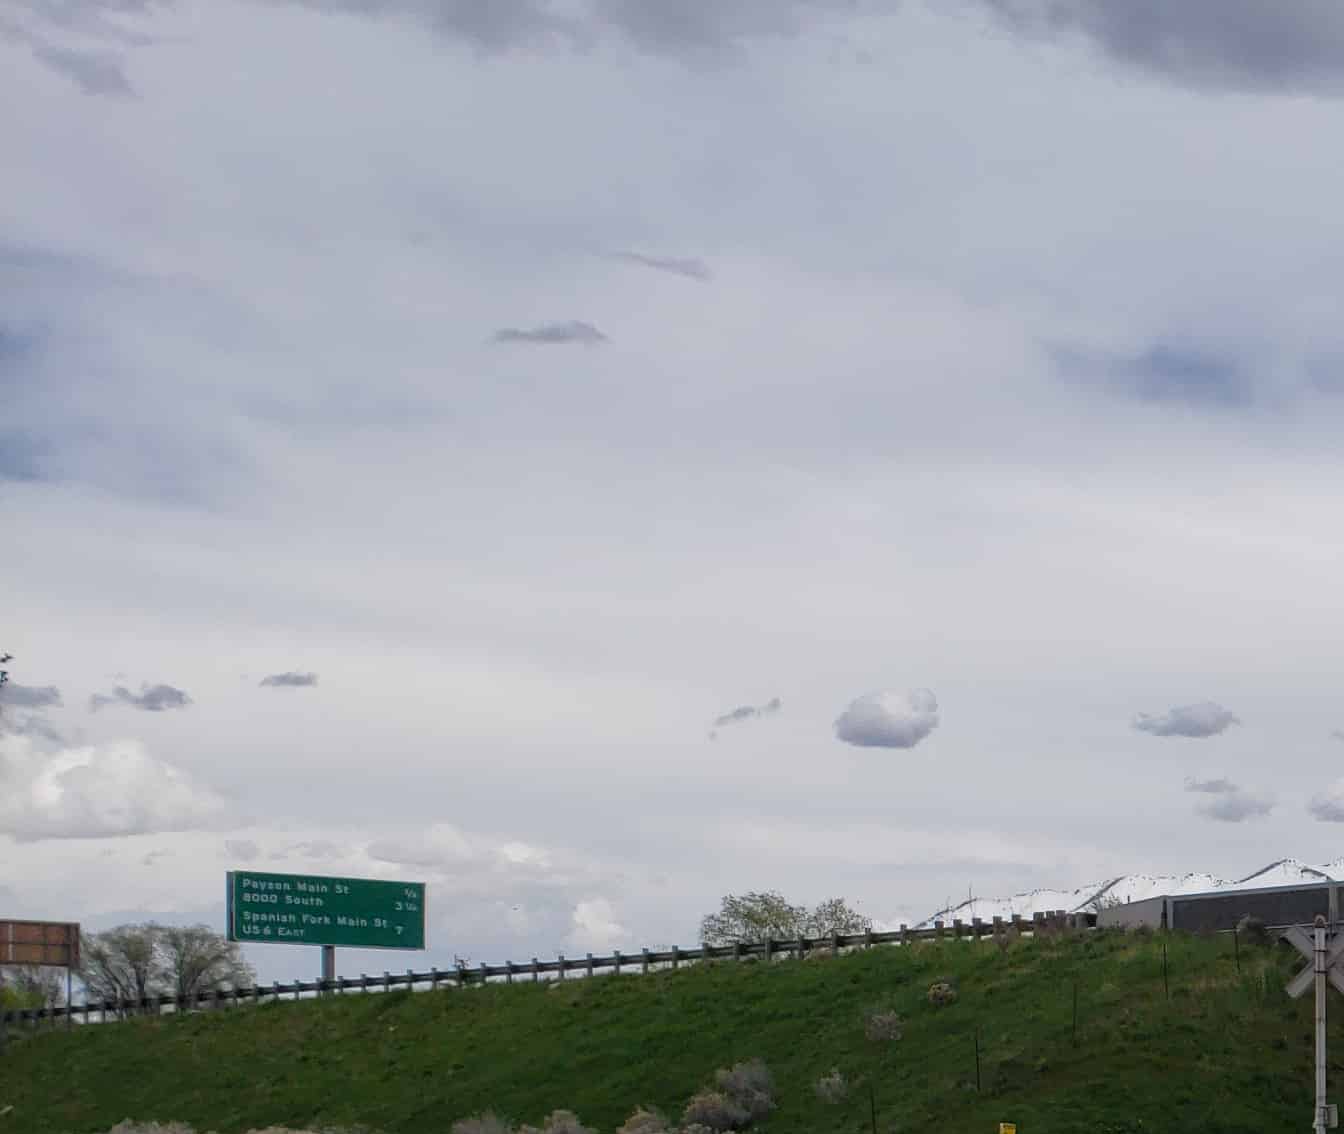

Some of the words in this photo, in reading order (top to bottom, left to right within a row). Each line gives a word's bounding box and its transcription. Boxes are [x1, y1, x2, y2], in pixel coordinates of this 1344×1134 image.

[242, 878, 291, 891] Payson
[297, 881, 328, 893] Main
[335, 884, 349, 894] St
[242, 893, 278, 904] 8000
[285, 895, 323, 907] South
[242, 911, 296, 923] Spanish
[302, 914, 331, 925] Fork
[336, 916, 368, 927] Main
[374, 918, 387, 929] St
